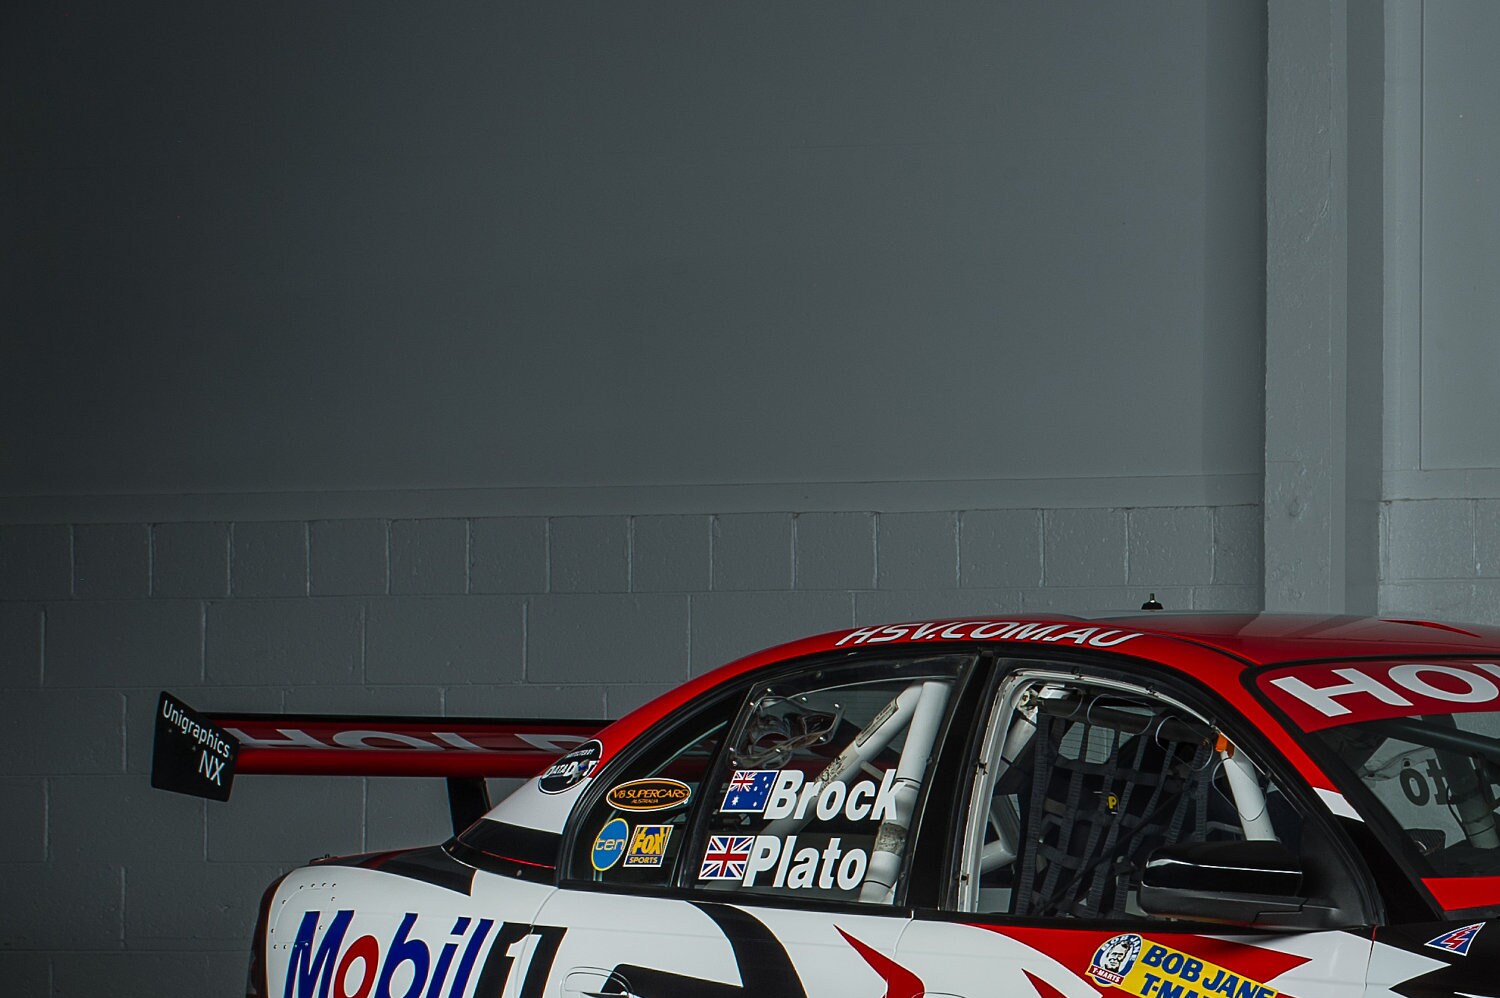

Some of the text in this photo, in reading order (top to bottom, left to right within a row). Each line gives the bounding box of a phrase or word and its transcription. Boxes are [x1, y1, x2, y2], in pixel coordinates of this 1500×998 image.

[162, 700, 231, 758] Unigraphics
[198, 749, 226, 786] NX
[625, 788, 688, 799] SUPERCARS
[763, 769, 909, 822] Brock
[595, 838, 625, 851] ten
[628, 856, 659, 865] SPORTS
[632, 831, 667, 855] FOX
[742, 835, 868, 891] Plato
[1141, 944, 1204, 983] BOB
